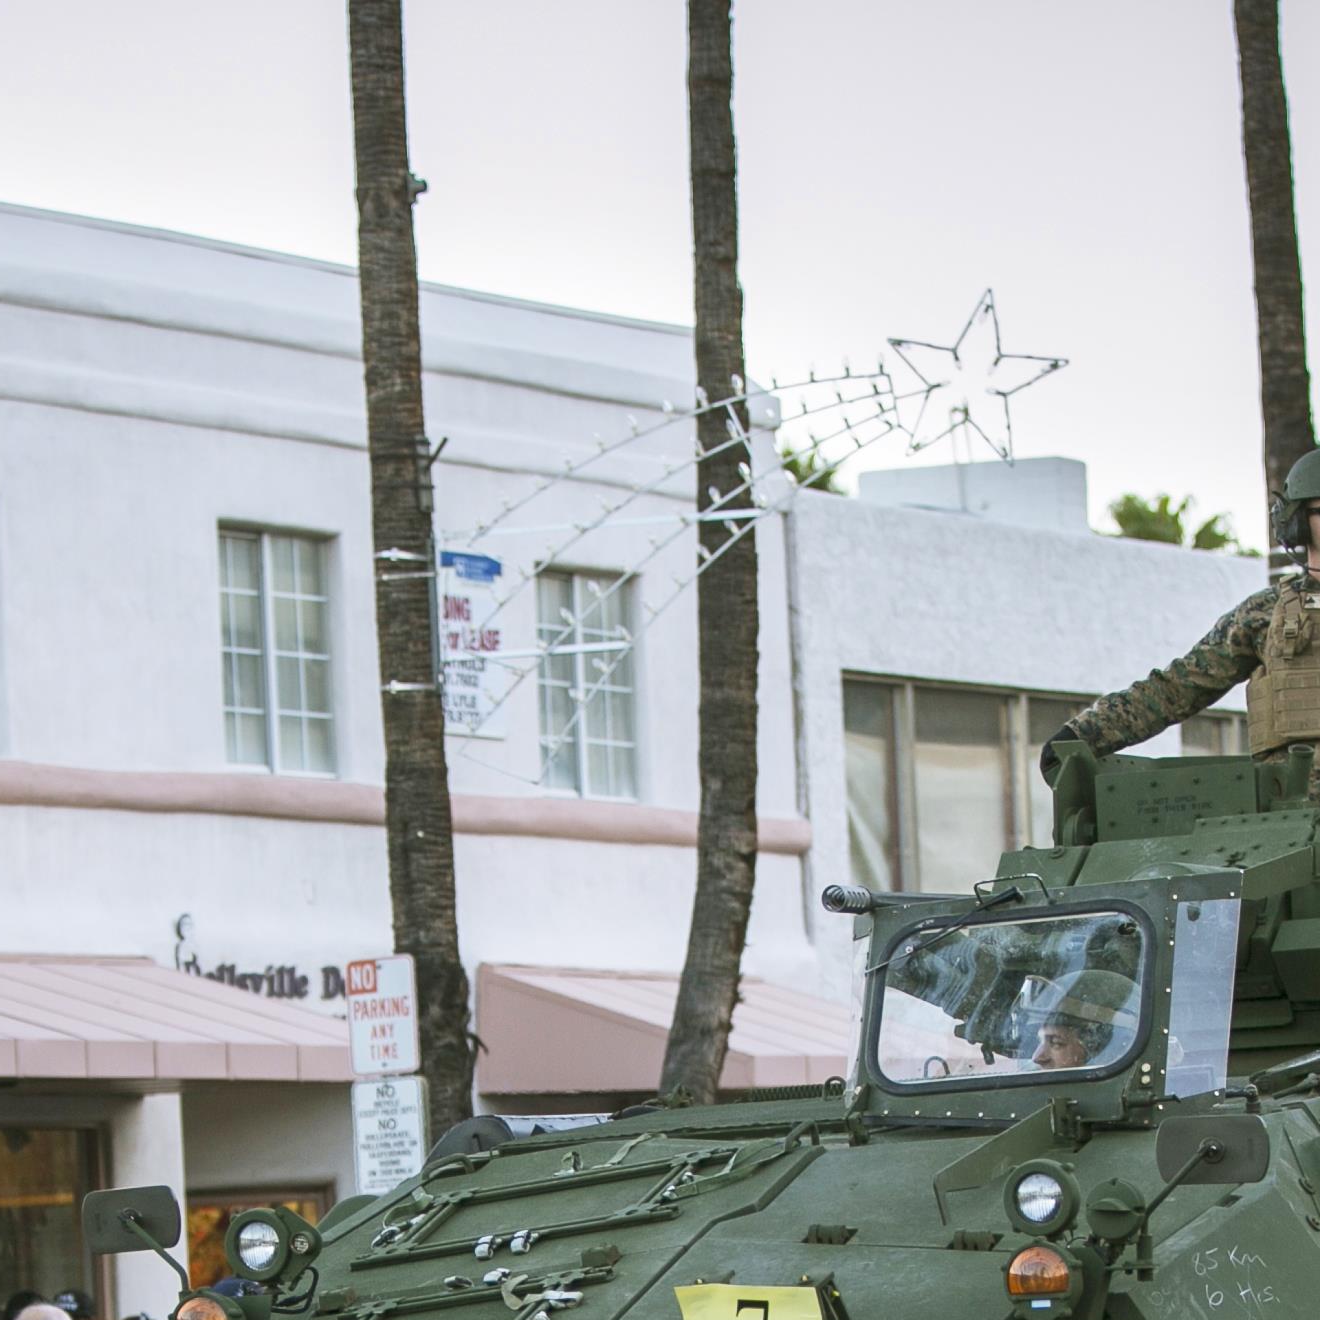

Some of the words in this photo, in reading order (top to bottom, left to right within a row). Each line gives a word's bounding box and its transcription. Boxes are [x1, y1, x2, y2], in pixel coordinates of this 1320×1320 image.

[350, 964, 375, 990] NO
[353, 997, 410, 1020] PARKING
[370, 1024, 394, 1041] ANY
[369, 1043, 399, 1061] TIME
[376, 1084, 395, 1098] NO
[377, 1118, 397, 1130] NO
[1193, 1247, 1219, 1276] 85
[1205, 1284, 1225, 1309] 6
